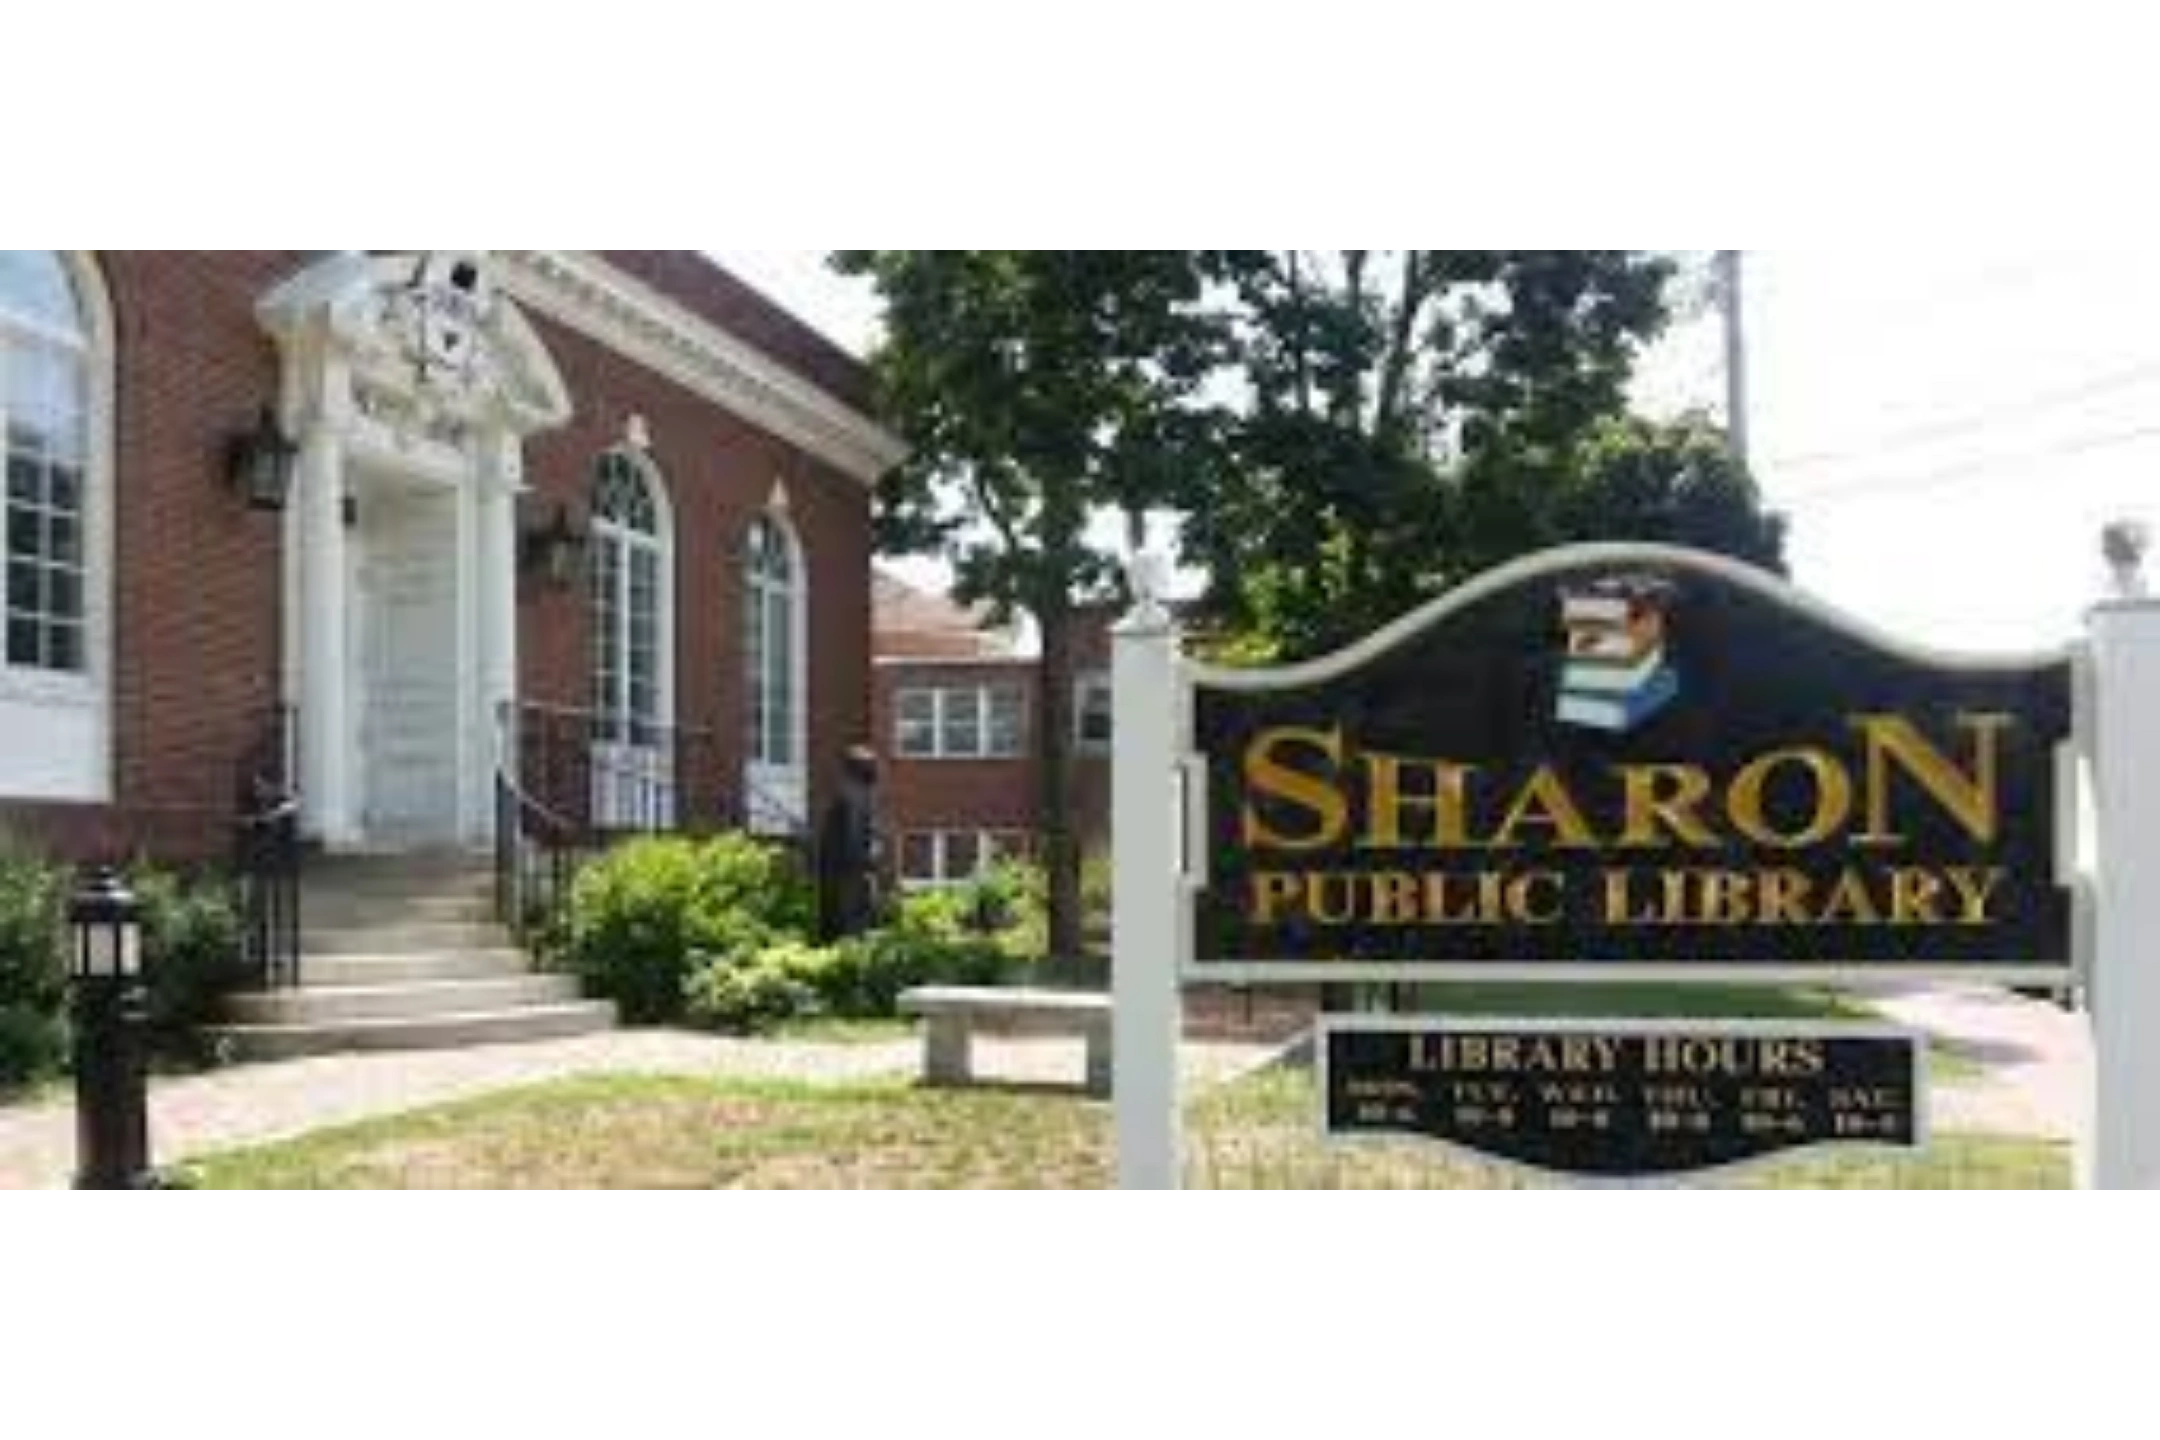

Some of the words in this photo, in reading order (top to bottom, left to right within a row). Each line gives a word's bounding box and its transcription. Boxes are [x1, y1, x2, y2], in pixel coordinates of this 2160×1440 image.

[1242, 711, 2014, 849] SHARON
[1252, 870, 1564, 925] PUBLIC
[1606, 867, 2001, 925] LIBRARY
[1409, 1037, 1622, 1072] LIBRARY
[1643, 1038, 1825, 1074] HOURS
